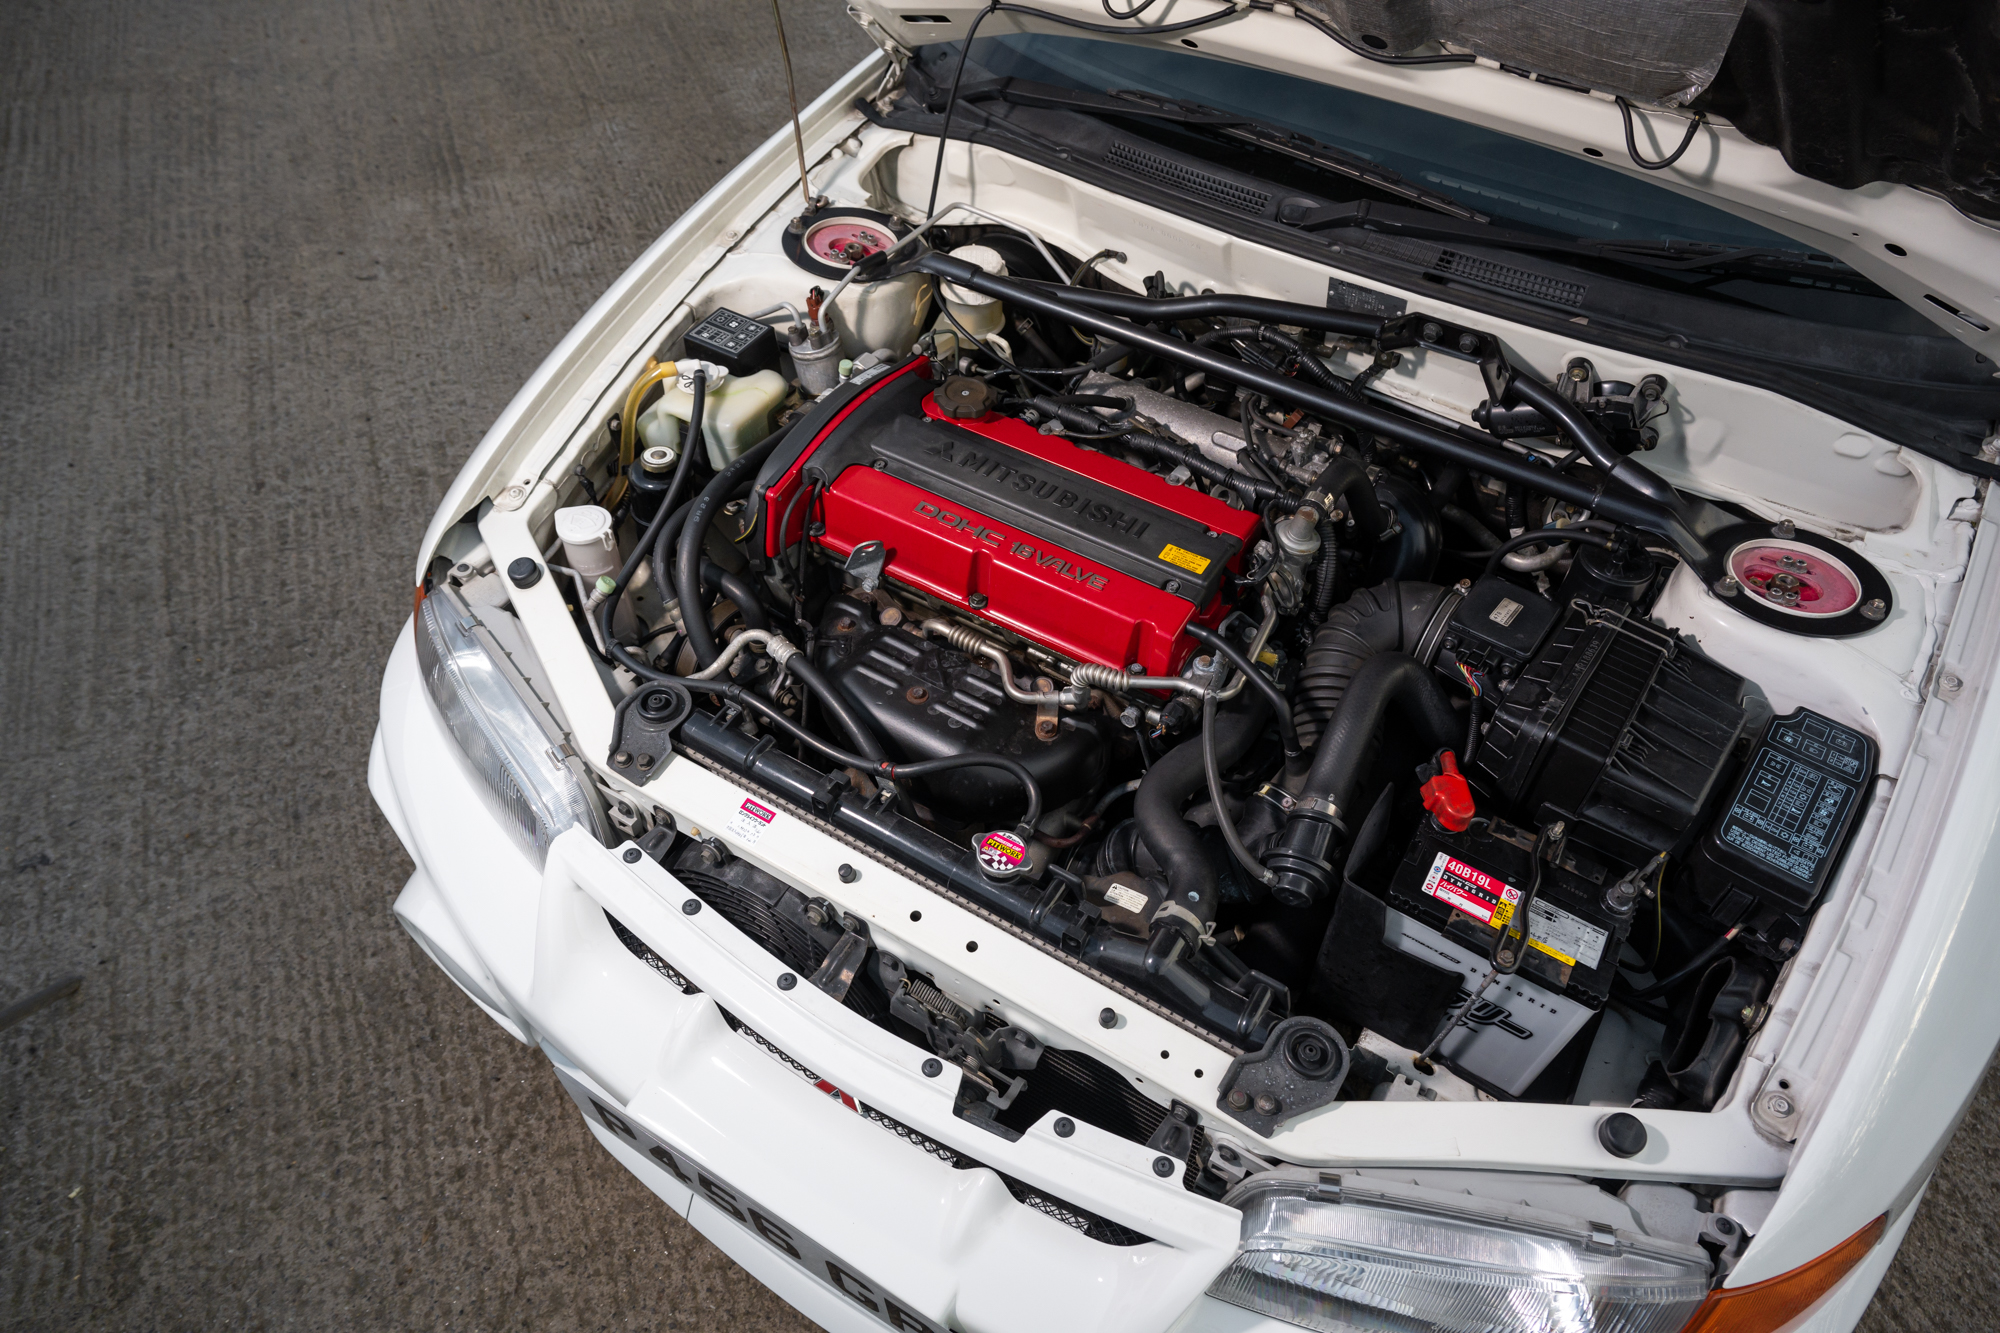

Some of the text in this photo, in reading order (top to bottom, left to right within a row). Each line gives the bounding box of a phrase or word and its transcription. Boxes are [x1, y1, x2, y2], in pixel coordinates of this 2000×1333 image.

[958, 451, 1150, 539] MITSUBISHI
[913, 501, 1007, 547] DOHC
[986, 838, 1023, 860] PITWORK
[1750, 839, 1782, 857] DESIGNATED
[1440, 881, 1468, 897] ハイパワー
[1442, 874, 1497, 904] DYNAGRID
[1447, 861, 1491, 890] 40B19L
[1401, 932, 1439, 953] AUTOBACS
[1470, 967, 1557, 1015] DYNAGRID
[588, 1096, 802, 1260] P456
